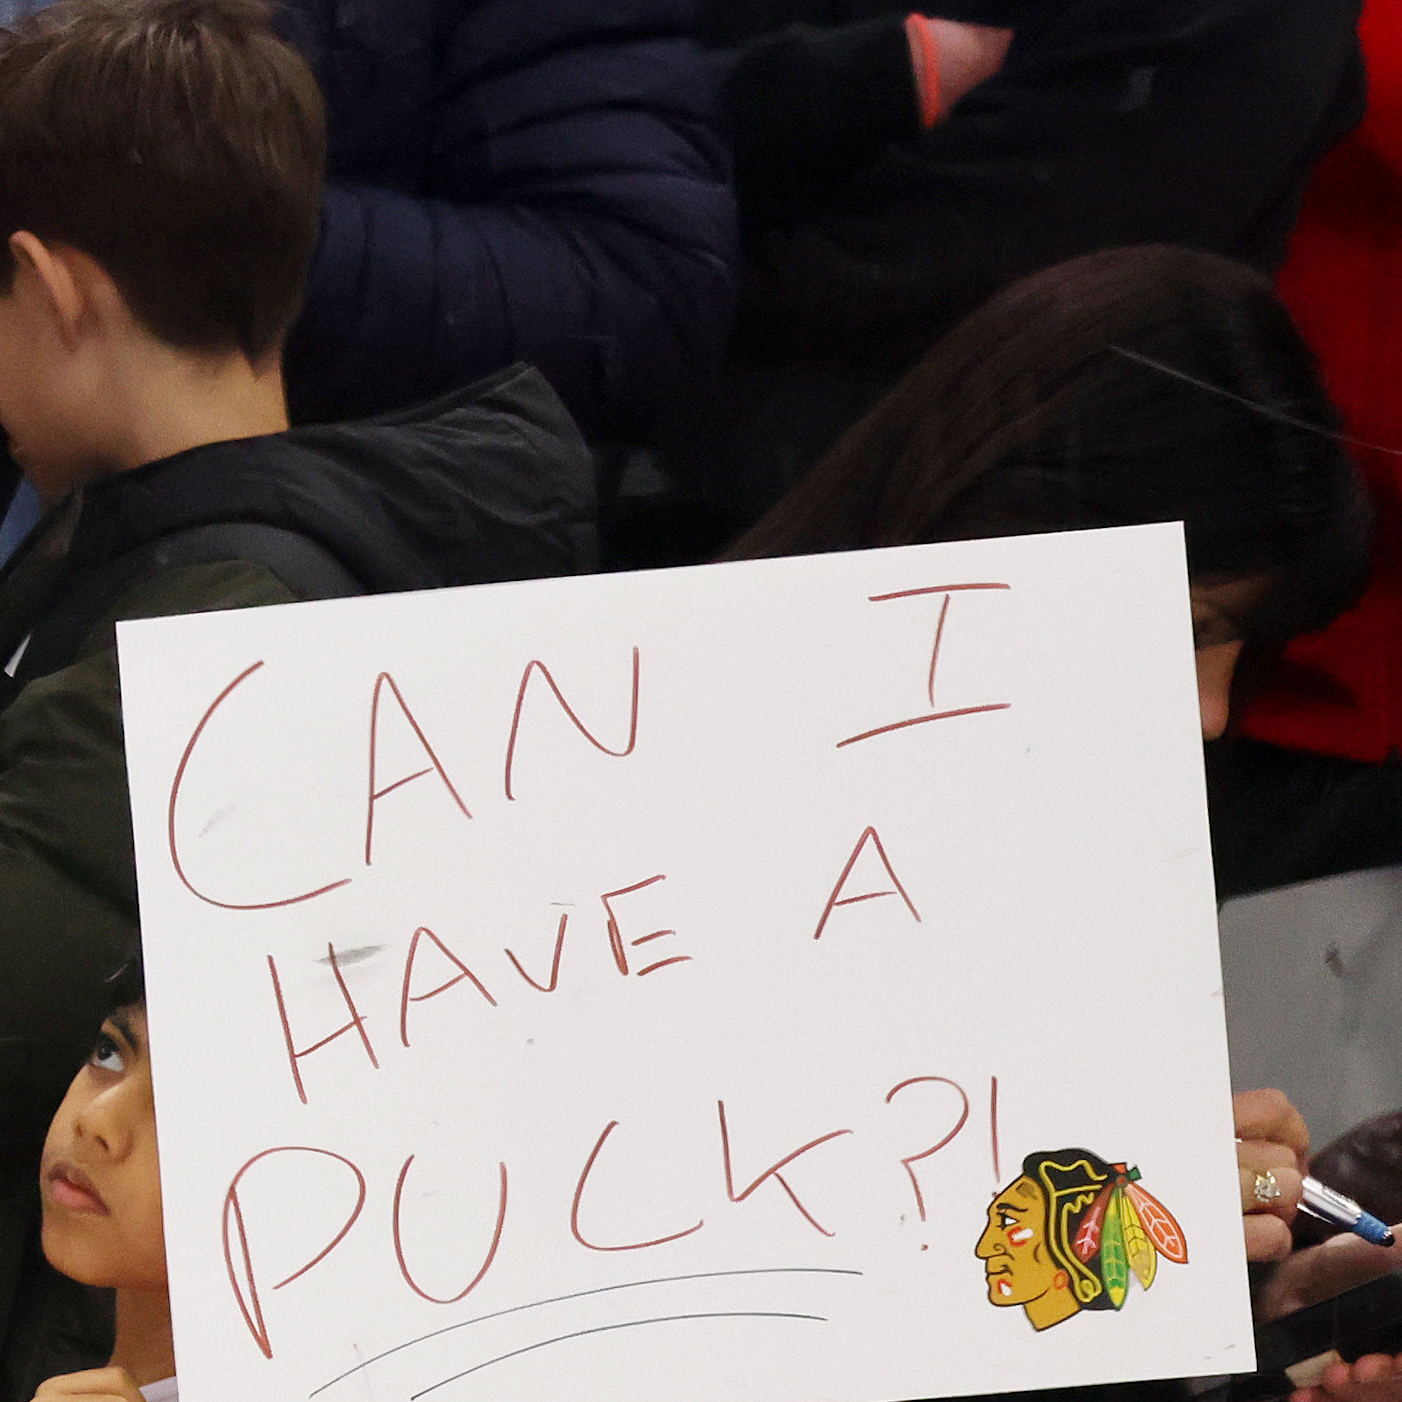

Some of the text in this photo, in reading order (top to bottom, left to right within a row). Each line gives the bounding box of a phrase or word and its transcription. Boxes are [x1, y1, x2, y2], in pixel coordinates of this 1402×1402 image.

[168, 582, 1012, 910] CAN I
[266, 825, 922, 1105] HAVE A
